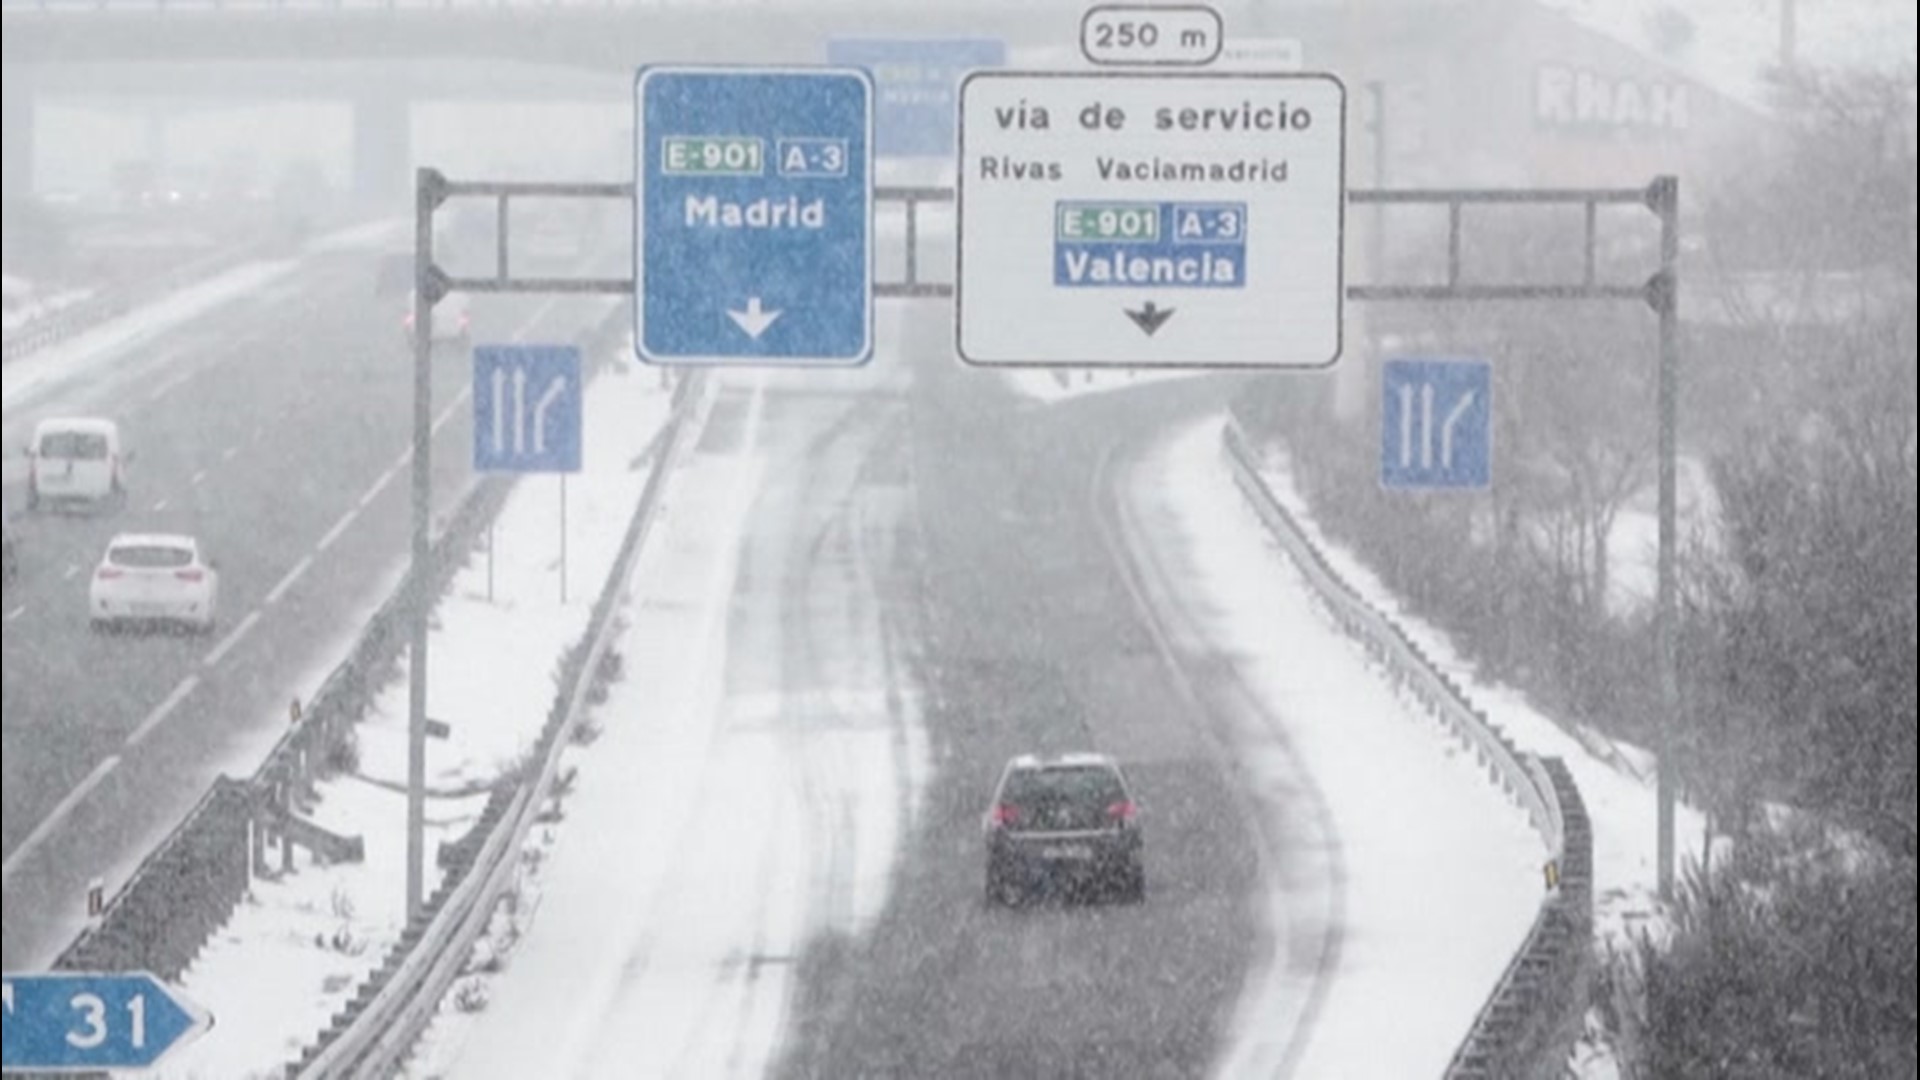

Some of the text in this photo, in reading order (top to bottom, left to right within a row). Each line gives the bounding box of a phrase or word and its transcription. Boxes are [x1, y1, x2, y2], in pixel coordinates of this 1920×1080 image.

[1094, 22, 1206, 48] 250 m
[1079, 102, 1126, 130] de
[1155, 101, 1312, 130] servicio
[668, 144, 843, 170] E-901 A-3
[980, 156, 1288, 182] Rivas Vaciamadrid
[685, 194, 825, 228] Madrid
[1063, 211, 1237, 236] E-901 A-3
[1065, 250, 1235, 283] Valencia
[66, 992, 146, 1049] 31
